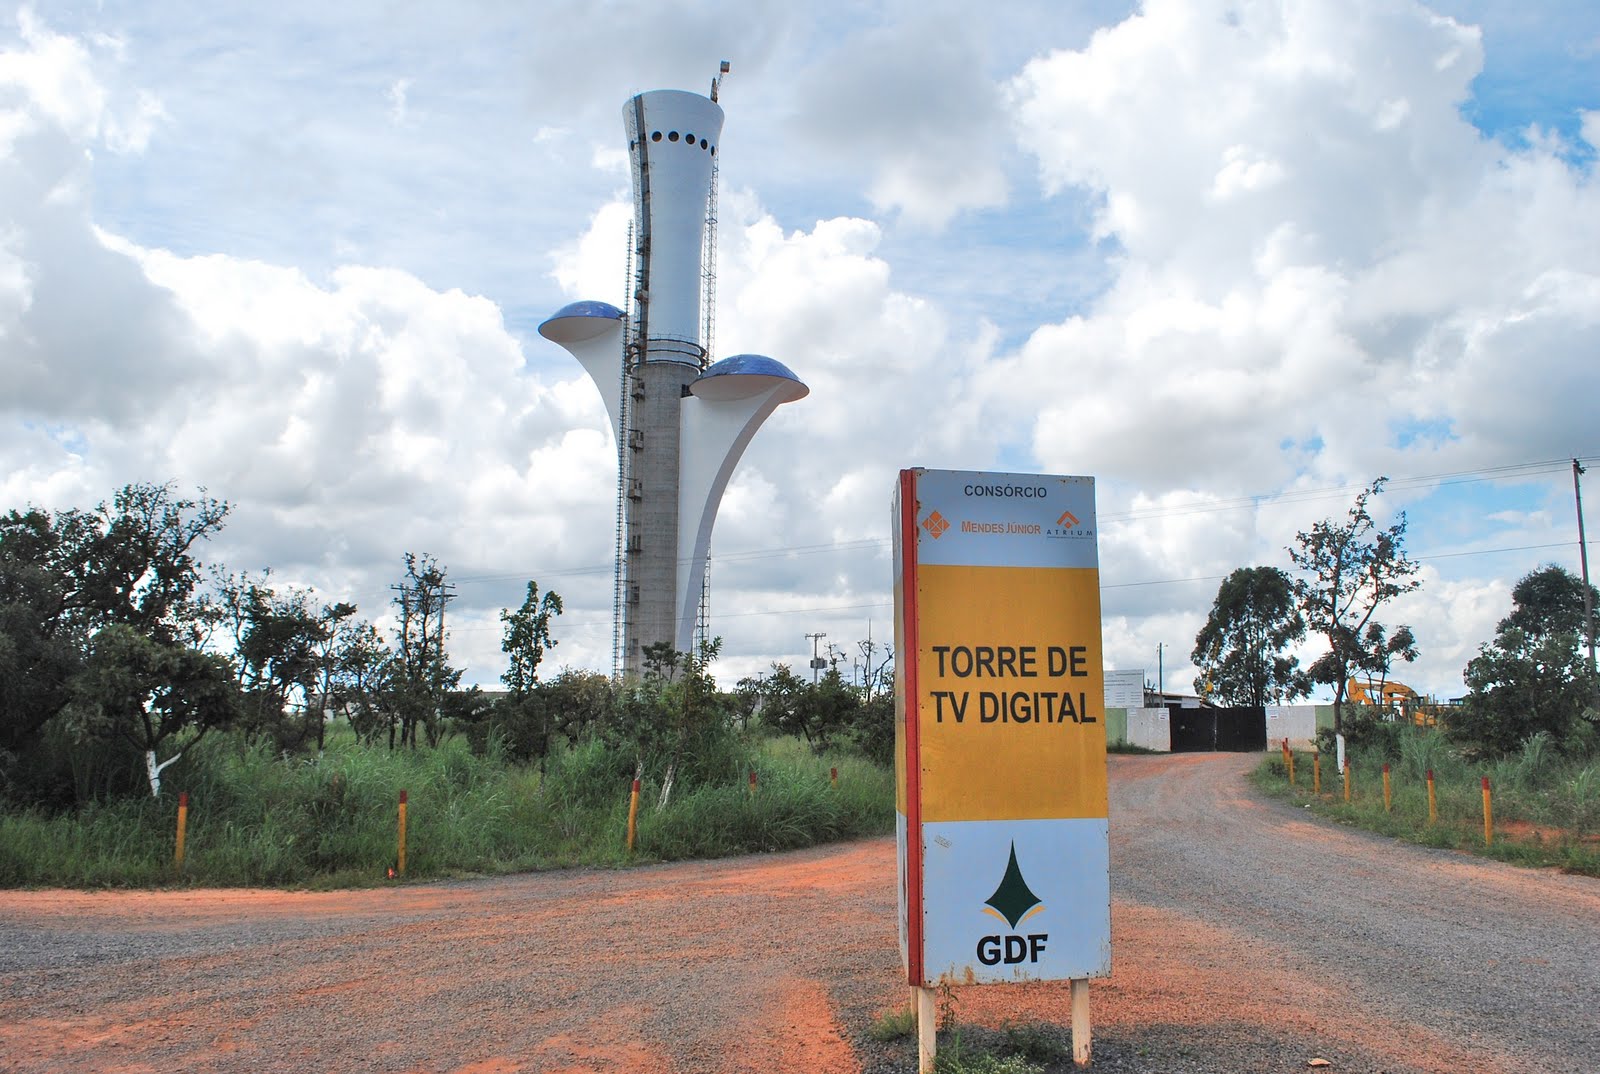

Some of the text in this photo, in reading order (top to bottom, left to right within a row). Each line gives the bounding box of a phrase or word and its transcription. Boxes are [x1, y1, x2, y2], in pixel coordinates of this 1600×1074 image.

[964, 484, 1047, 498] CONSÓRCIO
[961, 521, 1041, 535] MENDES JÚNIOR
[932, 646, 1088, 677] TORRE DE
[930, 691, 1097, 723] TV DIGITAL
[976, 934, 1048, 966] GDF
